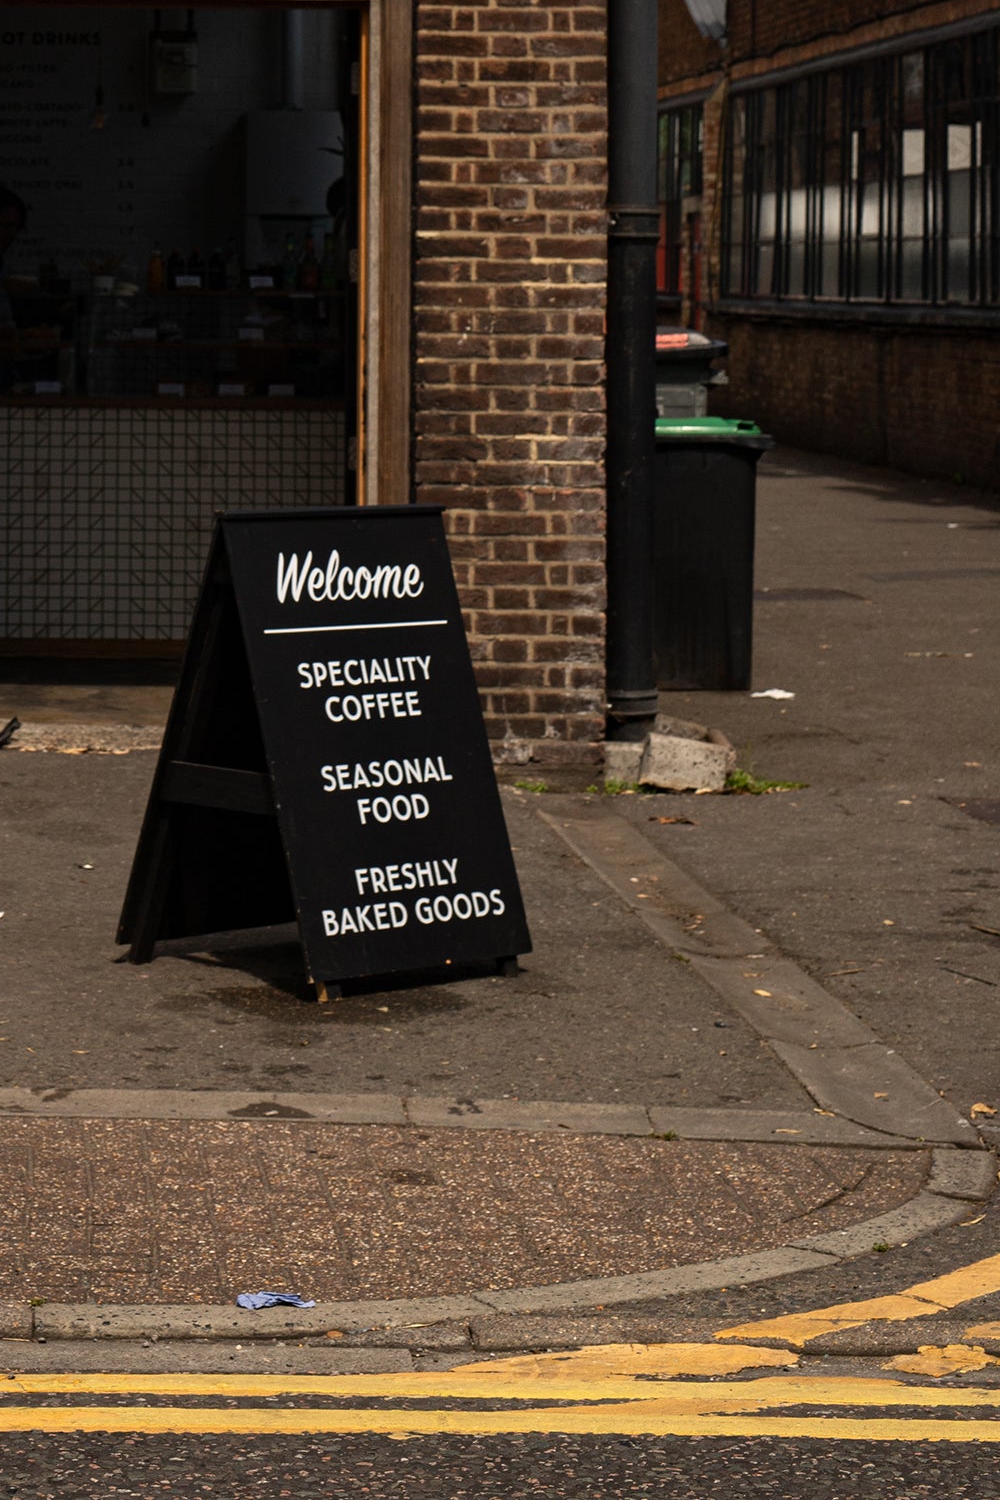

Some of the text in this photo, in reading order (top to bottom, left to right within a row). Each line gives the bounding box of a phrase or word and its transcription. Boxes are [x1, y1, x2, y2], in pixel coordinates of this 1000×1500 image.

[276, 549, 425, 604] Welcome
[297, 655, 431, 689] SPECIALITY
[324, 690, 422, 723] COFFEE
[320, 755, 453, 792] SEASONAL
[356, 793, 430, 825] FOOD
[354, 858, 458, 896] FRESHLY
[321, 888, 506, 937] BAKED GOODS
